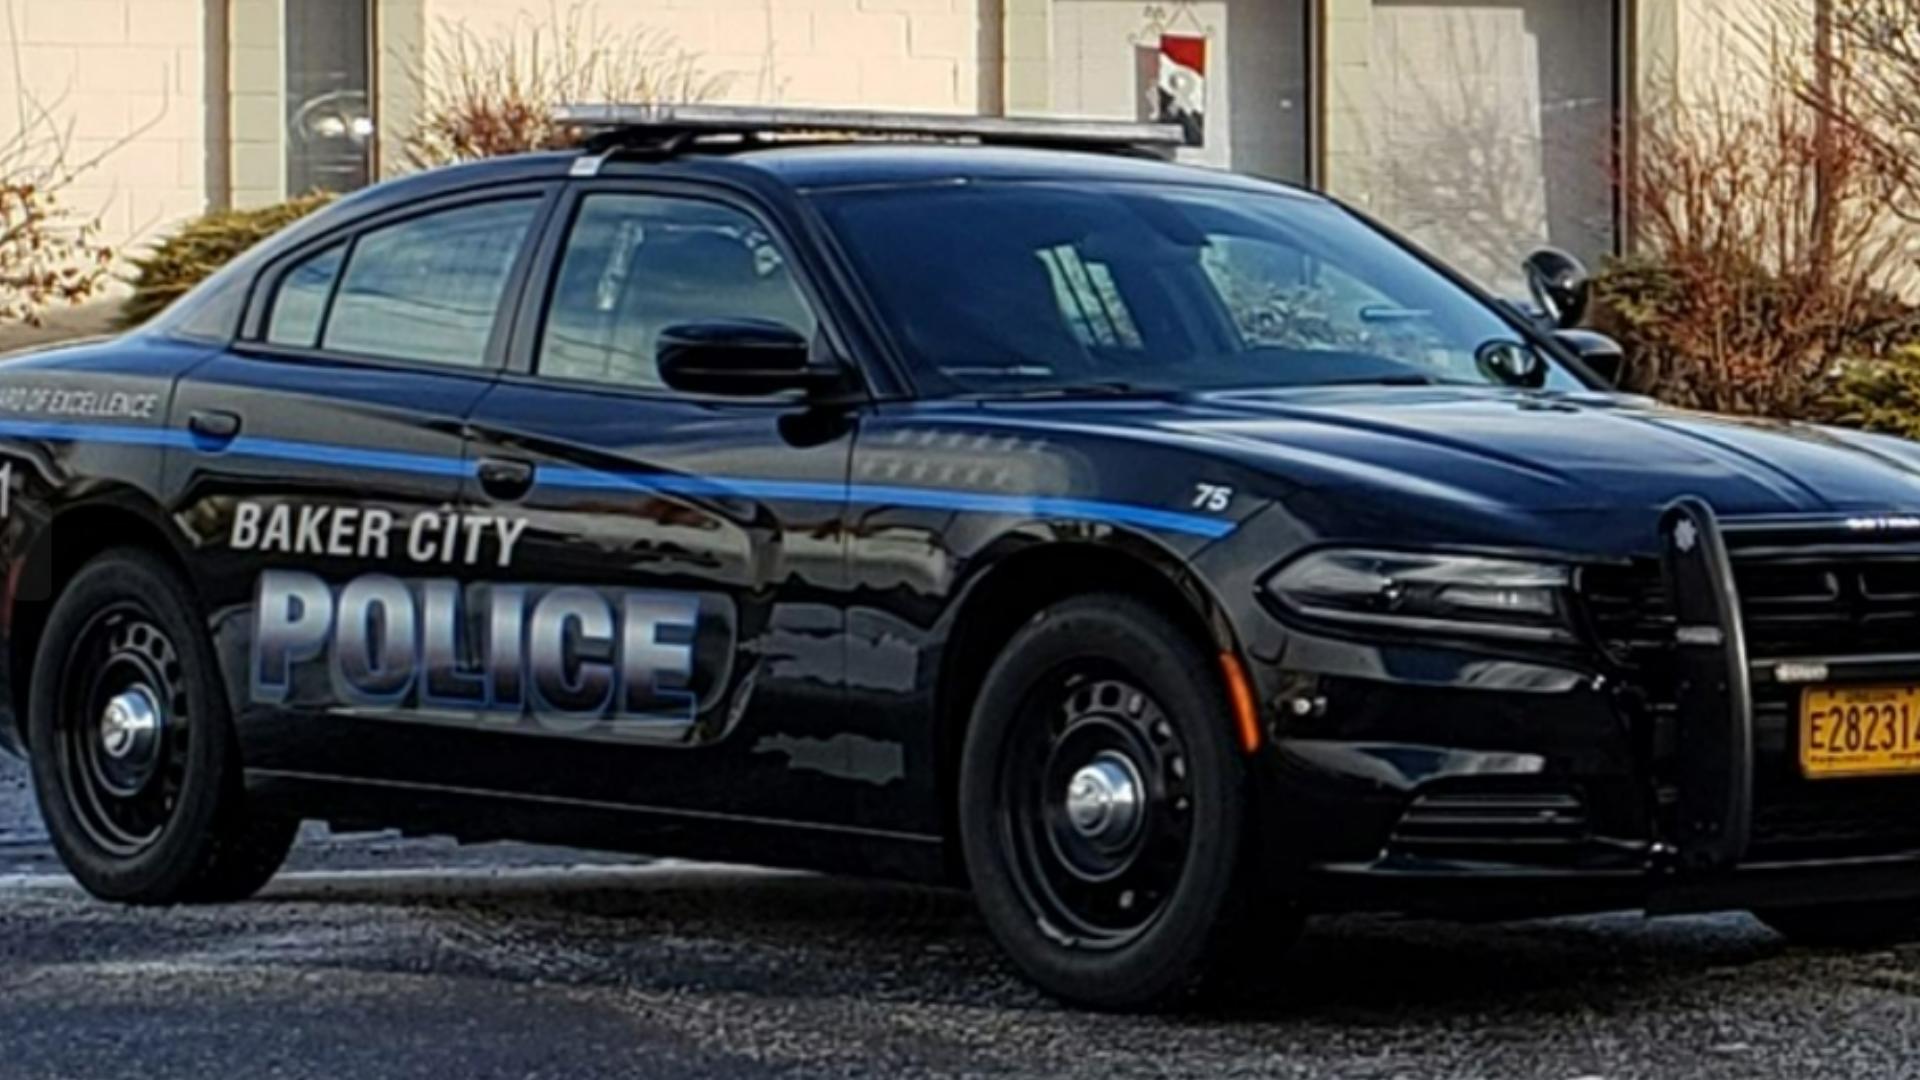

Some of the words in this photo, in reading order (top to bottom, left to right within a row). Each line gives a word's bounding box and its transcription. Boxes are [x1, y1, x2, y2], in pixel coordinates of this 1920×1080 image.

[48, 389, 158, 418] EXCELLENCE
[1192, 483, 1232, 511] 75
[230, 502, 392, 559] BAKER
[407, 511, 528, 567] CITY
[250, 569, 700, 728] POLICE
